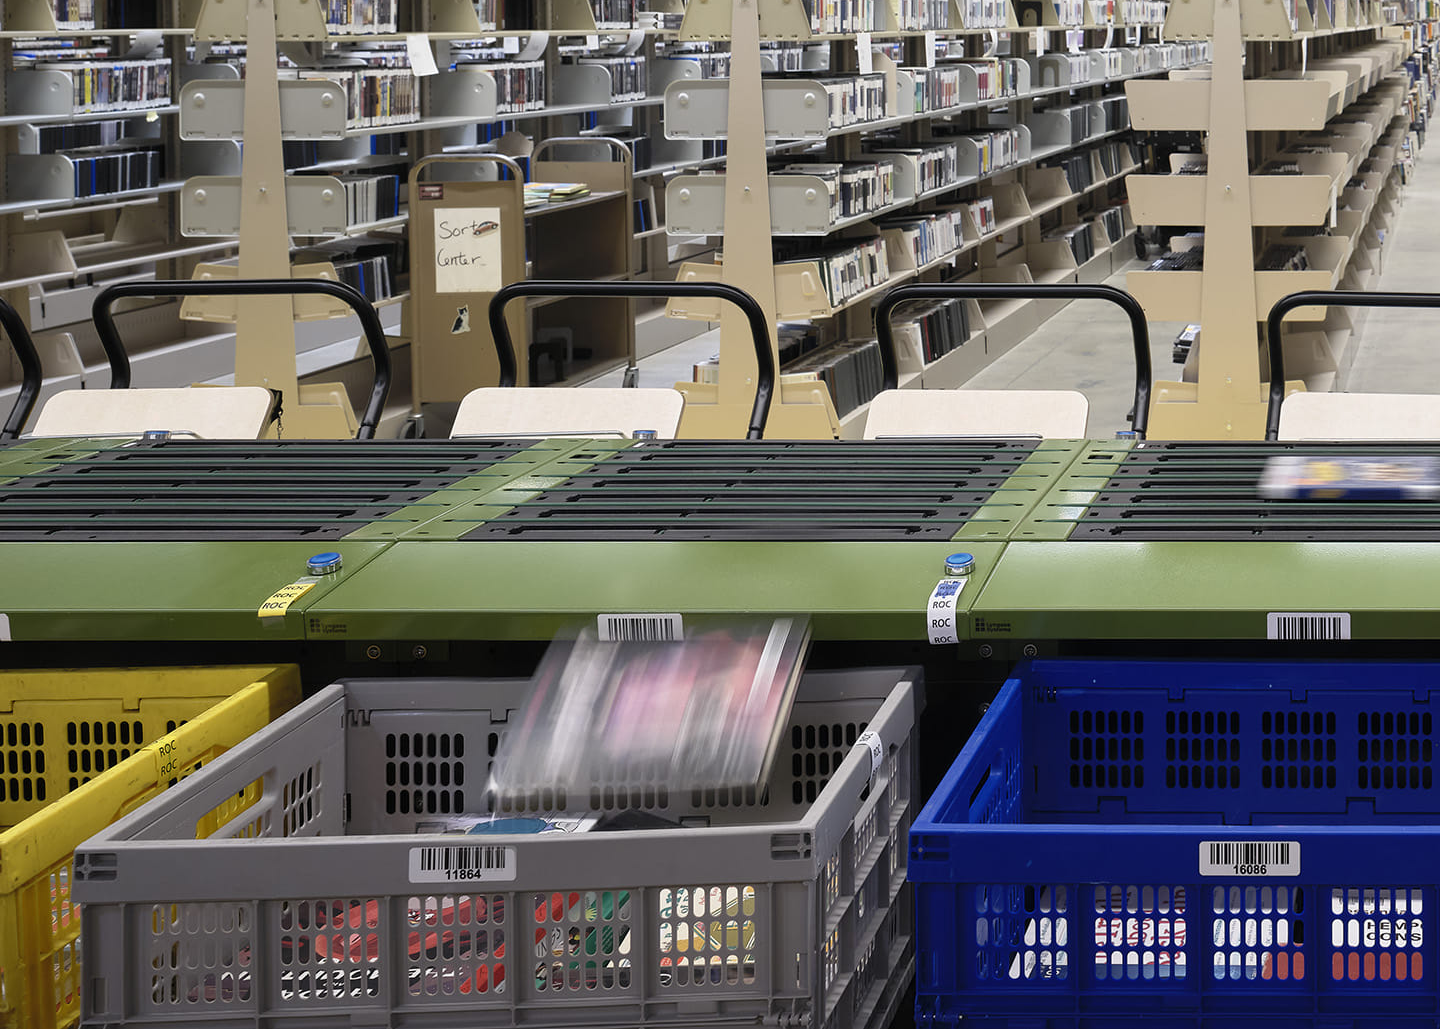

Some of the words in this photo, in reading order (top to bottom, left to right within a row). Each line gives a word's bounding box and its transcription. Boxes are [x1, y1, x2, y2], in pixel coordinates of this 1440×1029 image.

[439, 220, 479, 240] Sort
[437, 248, 481, 267] Center
[932, 600, 952, 609] ROC
[932, 618, 951, 628] ROC
[159, 740, 177, 757] ROC
[161, 758, 177, 776] ROC
[445, 869, 481, 880] 11864
[1233, 865, 1267, 874] 16086
